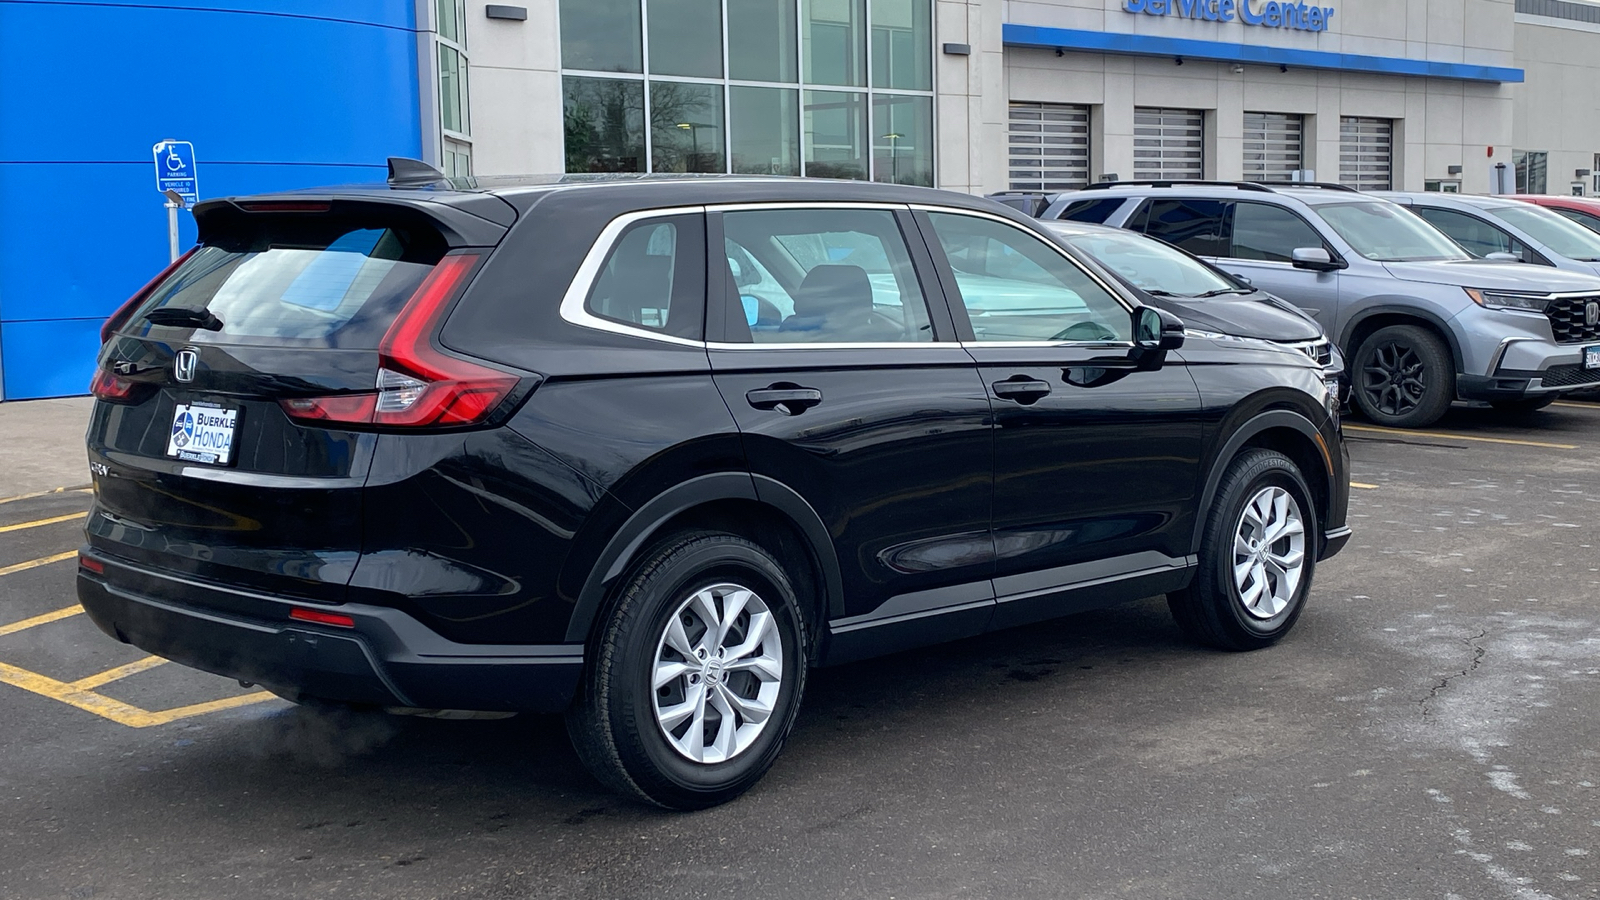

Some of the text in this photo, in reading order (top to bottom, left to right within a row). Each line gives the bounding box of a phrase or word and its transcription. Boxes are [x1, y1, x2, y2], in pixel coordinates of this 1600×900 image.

[1238, 0, 1335, 32] Center
[197, 412, 236, 429] BUERKLE
[192, 425, 231, 450] HONDA
